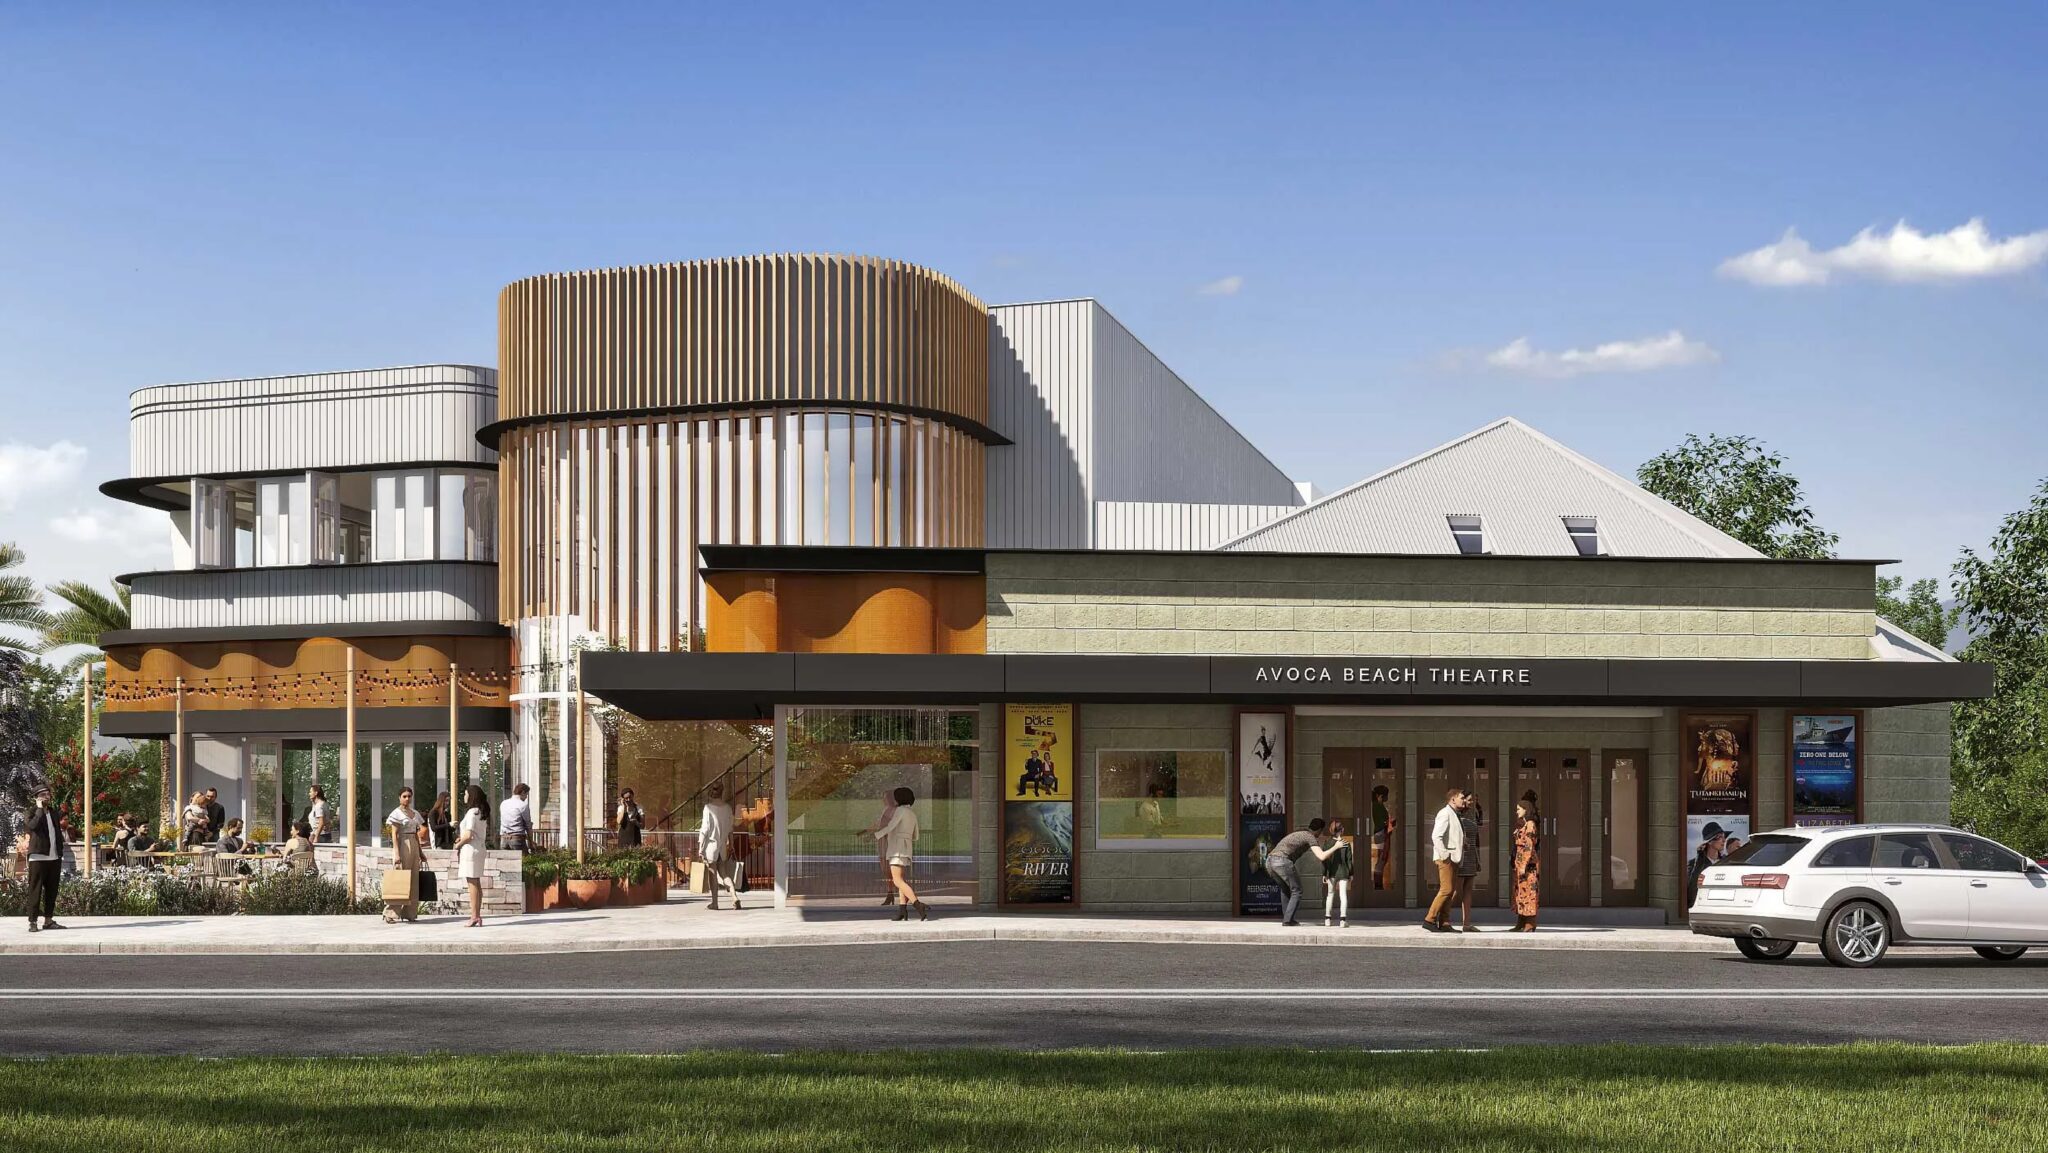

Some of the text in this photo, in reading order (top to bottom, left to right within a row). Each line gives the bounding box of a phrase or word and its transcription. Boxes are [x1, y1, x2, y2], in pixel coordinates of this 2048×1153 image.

[1255, 666, 1530, 683] AVOCA BEACH THEATRE
[1689, 790, 1747, 799] TUTANKHAMUN
[1796, 819, 1851, 827] ELIZABETH
[1023, 862, 1069, 876] RIVER
